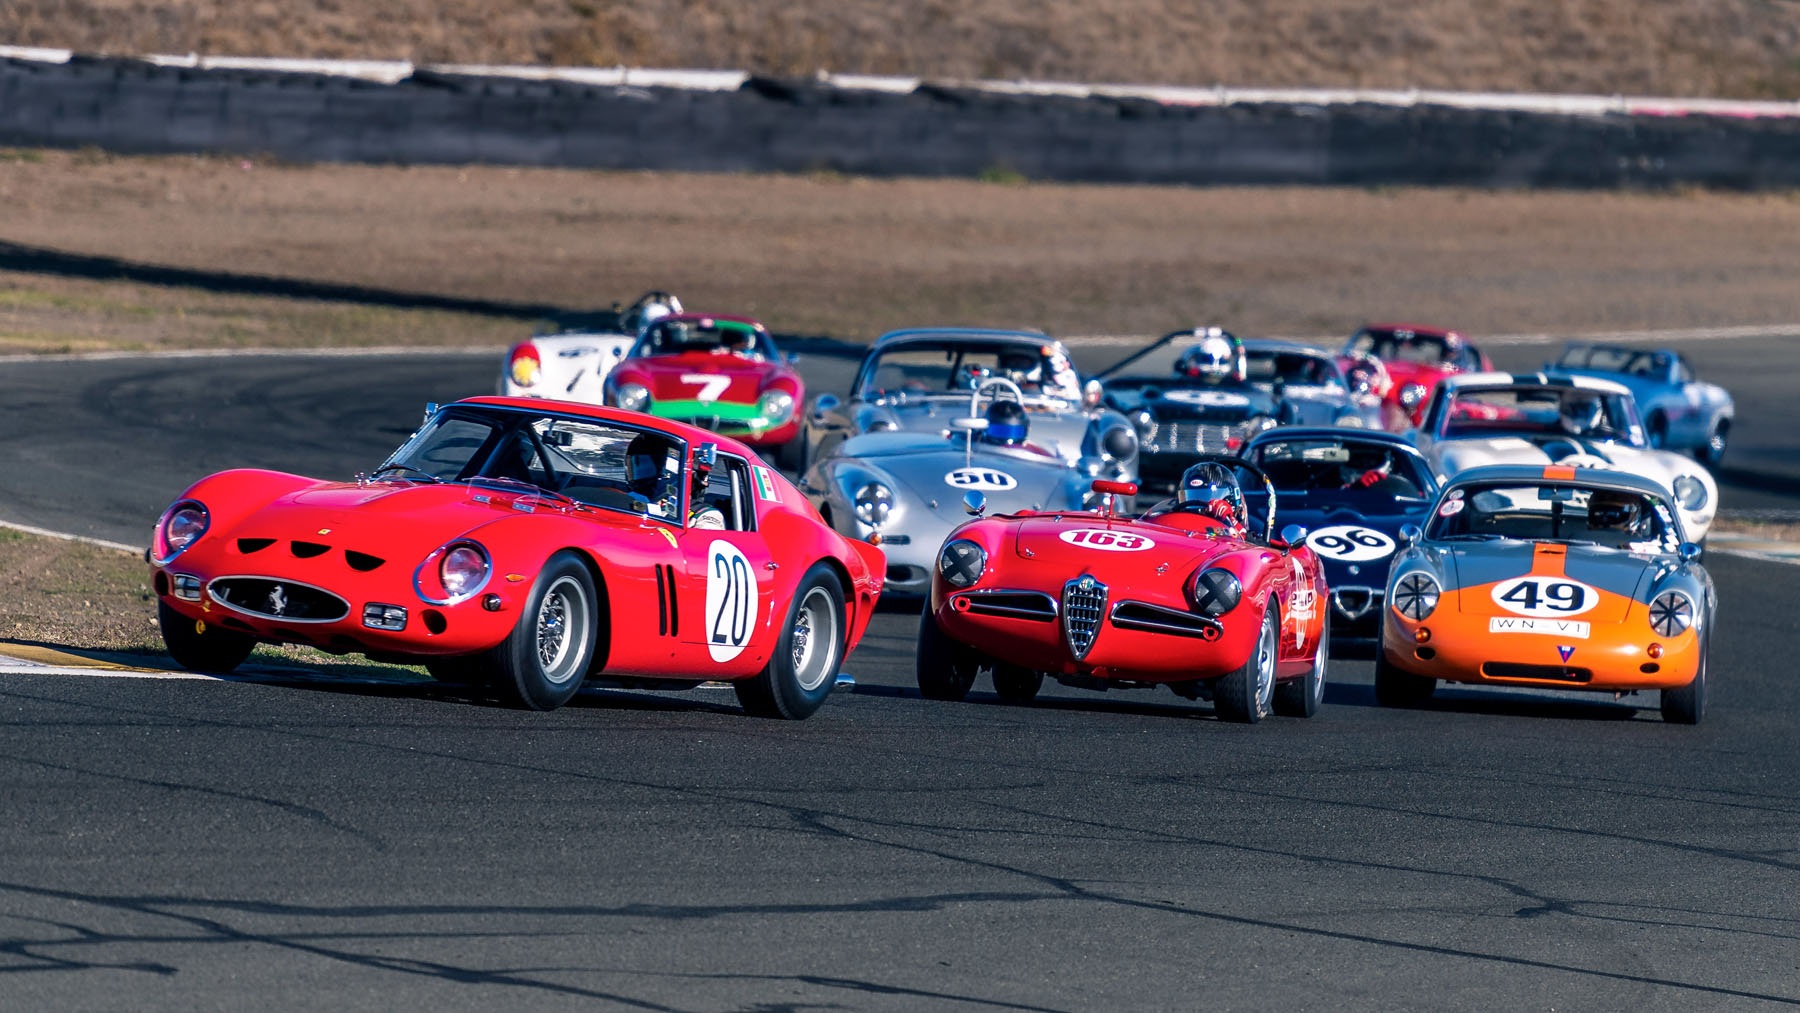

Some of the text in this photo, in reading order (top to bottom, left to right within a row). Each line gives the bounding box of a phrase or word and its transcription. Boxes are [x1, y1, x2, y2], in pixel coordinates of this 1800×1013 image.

[680, 374, 731, 401] 7
[953, 473, 1008, 486] 50
[1071, 531, 1145, 549] 163
[1314, 529, 1387, 555] 96
[712, 553, 749, 646] 20
[1500, 581, 1585, 611] 49
